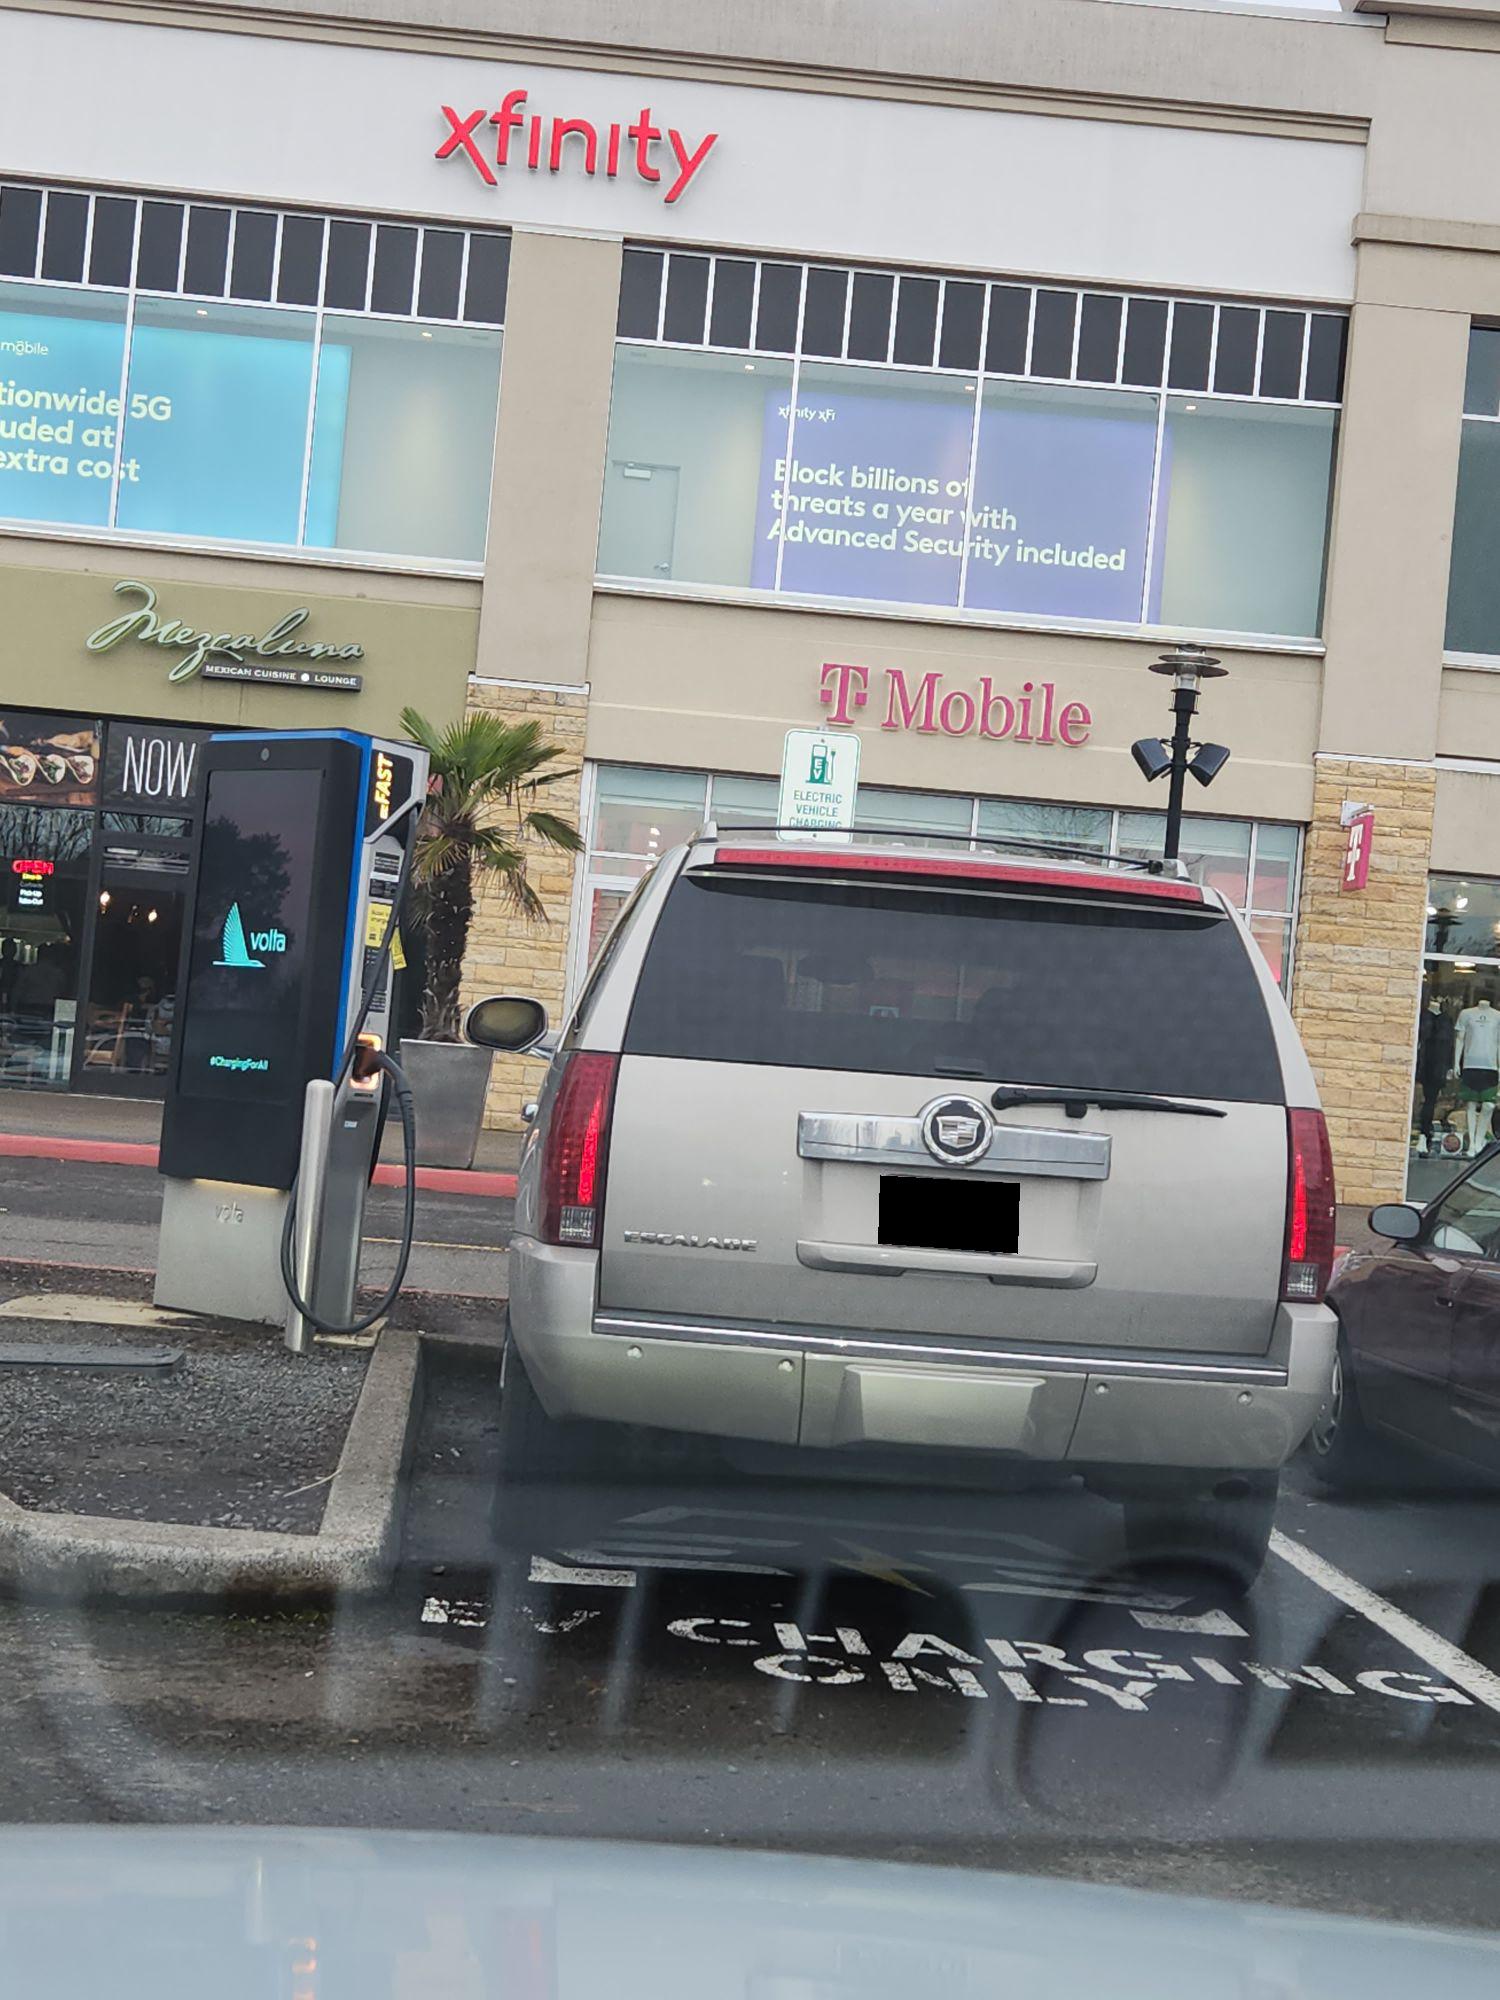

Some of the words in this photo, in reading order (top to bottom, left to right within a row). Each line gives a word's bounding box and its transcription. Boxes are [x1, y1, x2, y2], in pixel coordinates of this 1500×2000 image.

[434, 89, 719, 203] xfinity
[130, 392, 172, 421] 5G
[778, 404, 817, 421] xfnity
[81, 425, 116, 449] at
[774, 459, 845, 487] Block
[851, 465, 939, 496] billions
[771, 489, 866, 517] threats
[872, 502, 889, 520] a
[896, 504, 954, 527] year
[960, 505, 1016, 531] with
[767, 518, 898, 551] Advanced
[1016, 538, 1126, 571] included
[86, 580, 365, 682] Mezcaluna
[205, 664, 252, 677] MEXICAN
[254, 669, 297, 681] CUISINE
[314, 674, 358, 686] LOUNGE
[820, 663, 869, 724] T
[881, 668, 1092, 746] Mobile
[122, 736, 197, 798] NOW
[793, 789, 843, 805] ELECTRIC
[796, 803, 839, 818] VEHICLE
[250, 928, 286, 952] volta
[210, 1056, 269, 1072] #ChargingForAll
[624, 1230, 758, 1252] ESCALADE
[666, 1617, 1476, 1705] CHARGING
[753, 1653, 1159, 1711] ONLY
